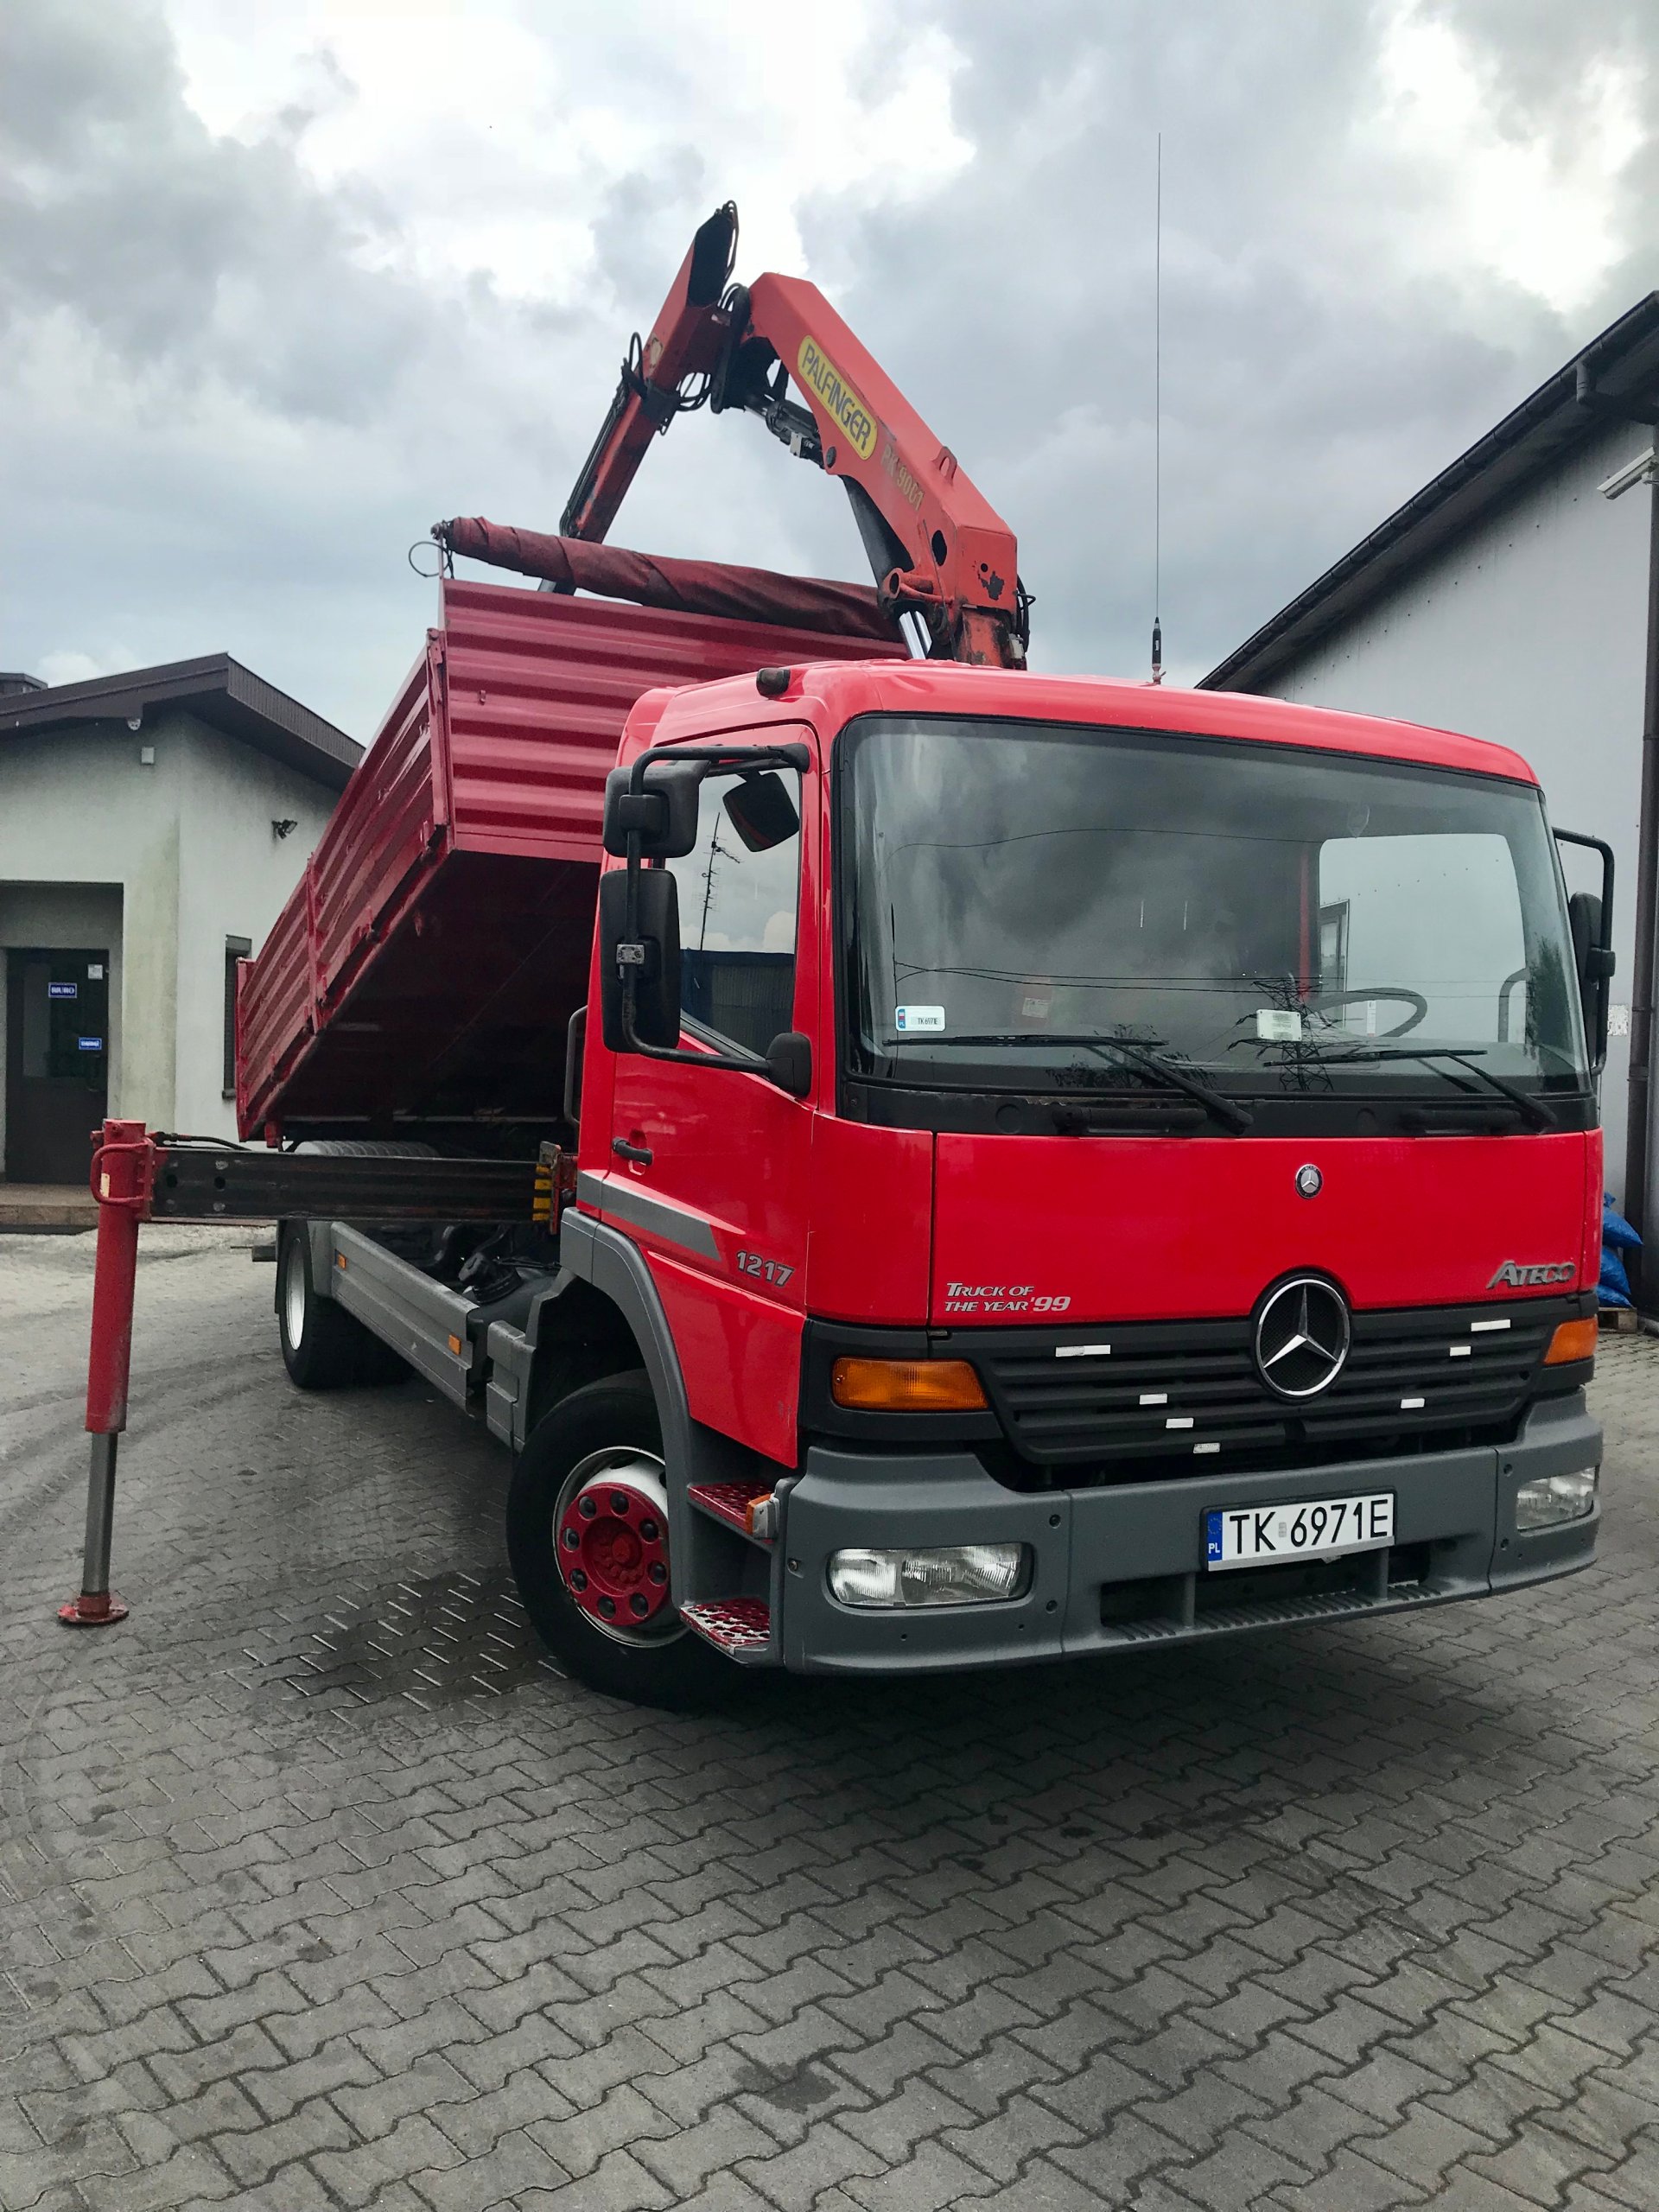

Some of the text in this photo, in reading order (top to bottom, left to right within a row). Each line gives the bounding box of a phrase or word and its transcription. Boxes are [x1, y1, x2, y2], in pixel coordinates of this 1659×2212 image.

[802, 344, 873, 452] PALFINGER
[737, 1250, 795, 1287] 1217
[1008, 1286, 1035, 1296] OF
[944, 1301, 979, 1312] THE
[1229, 1498, 1389, 1554] TK 6971E
[1208, 1542, 1221, 1554] PL
